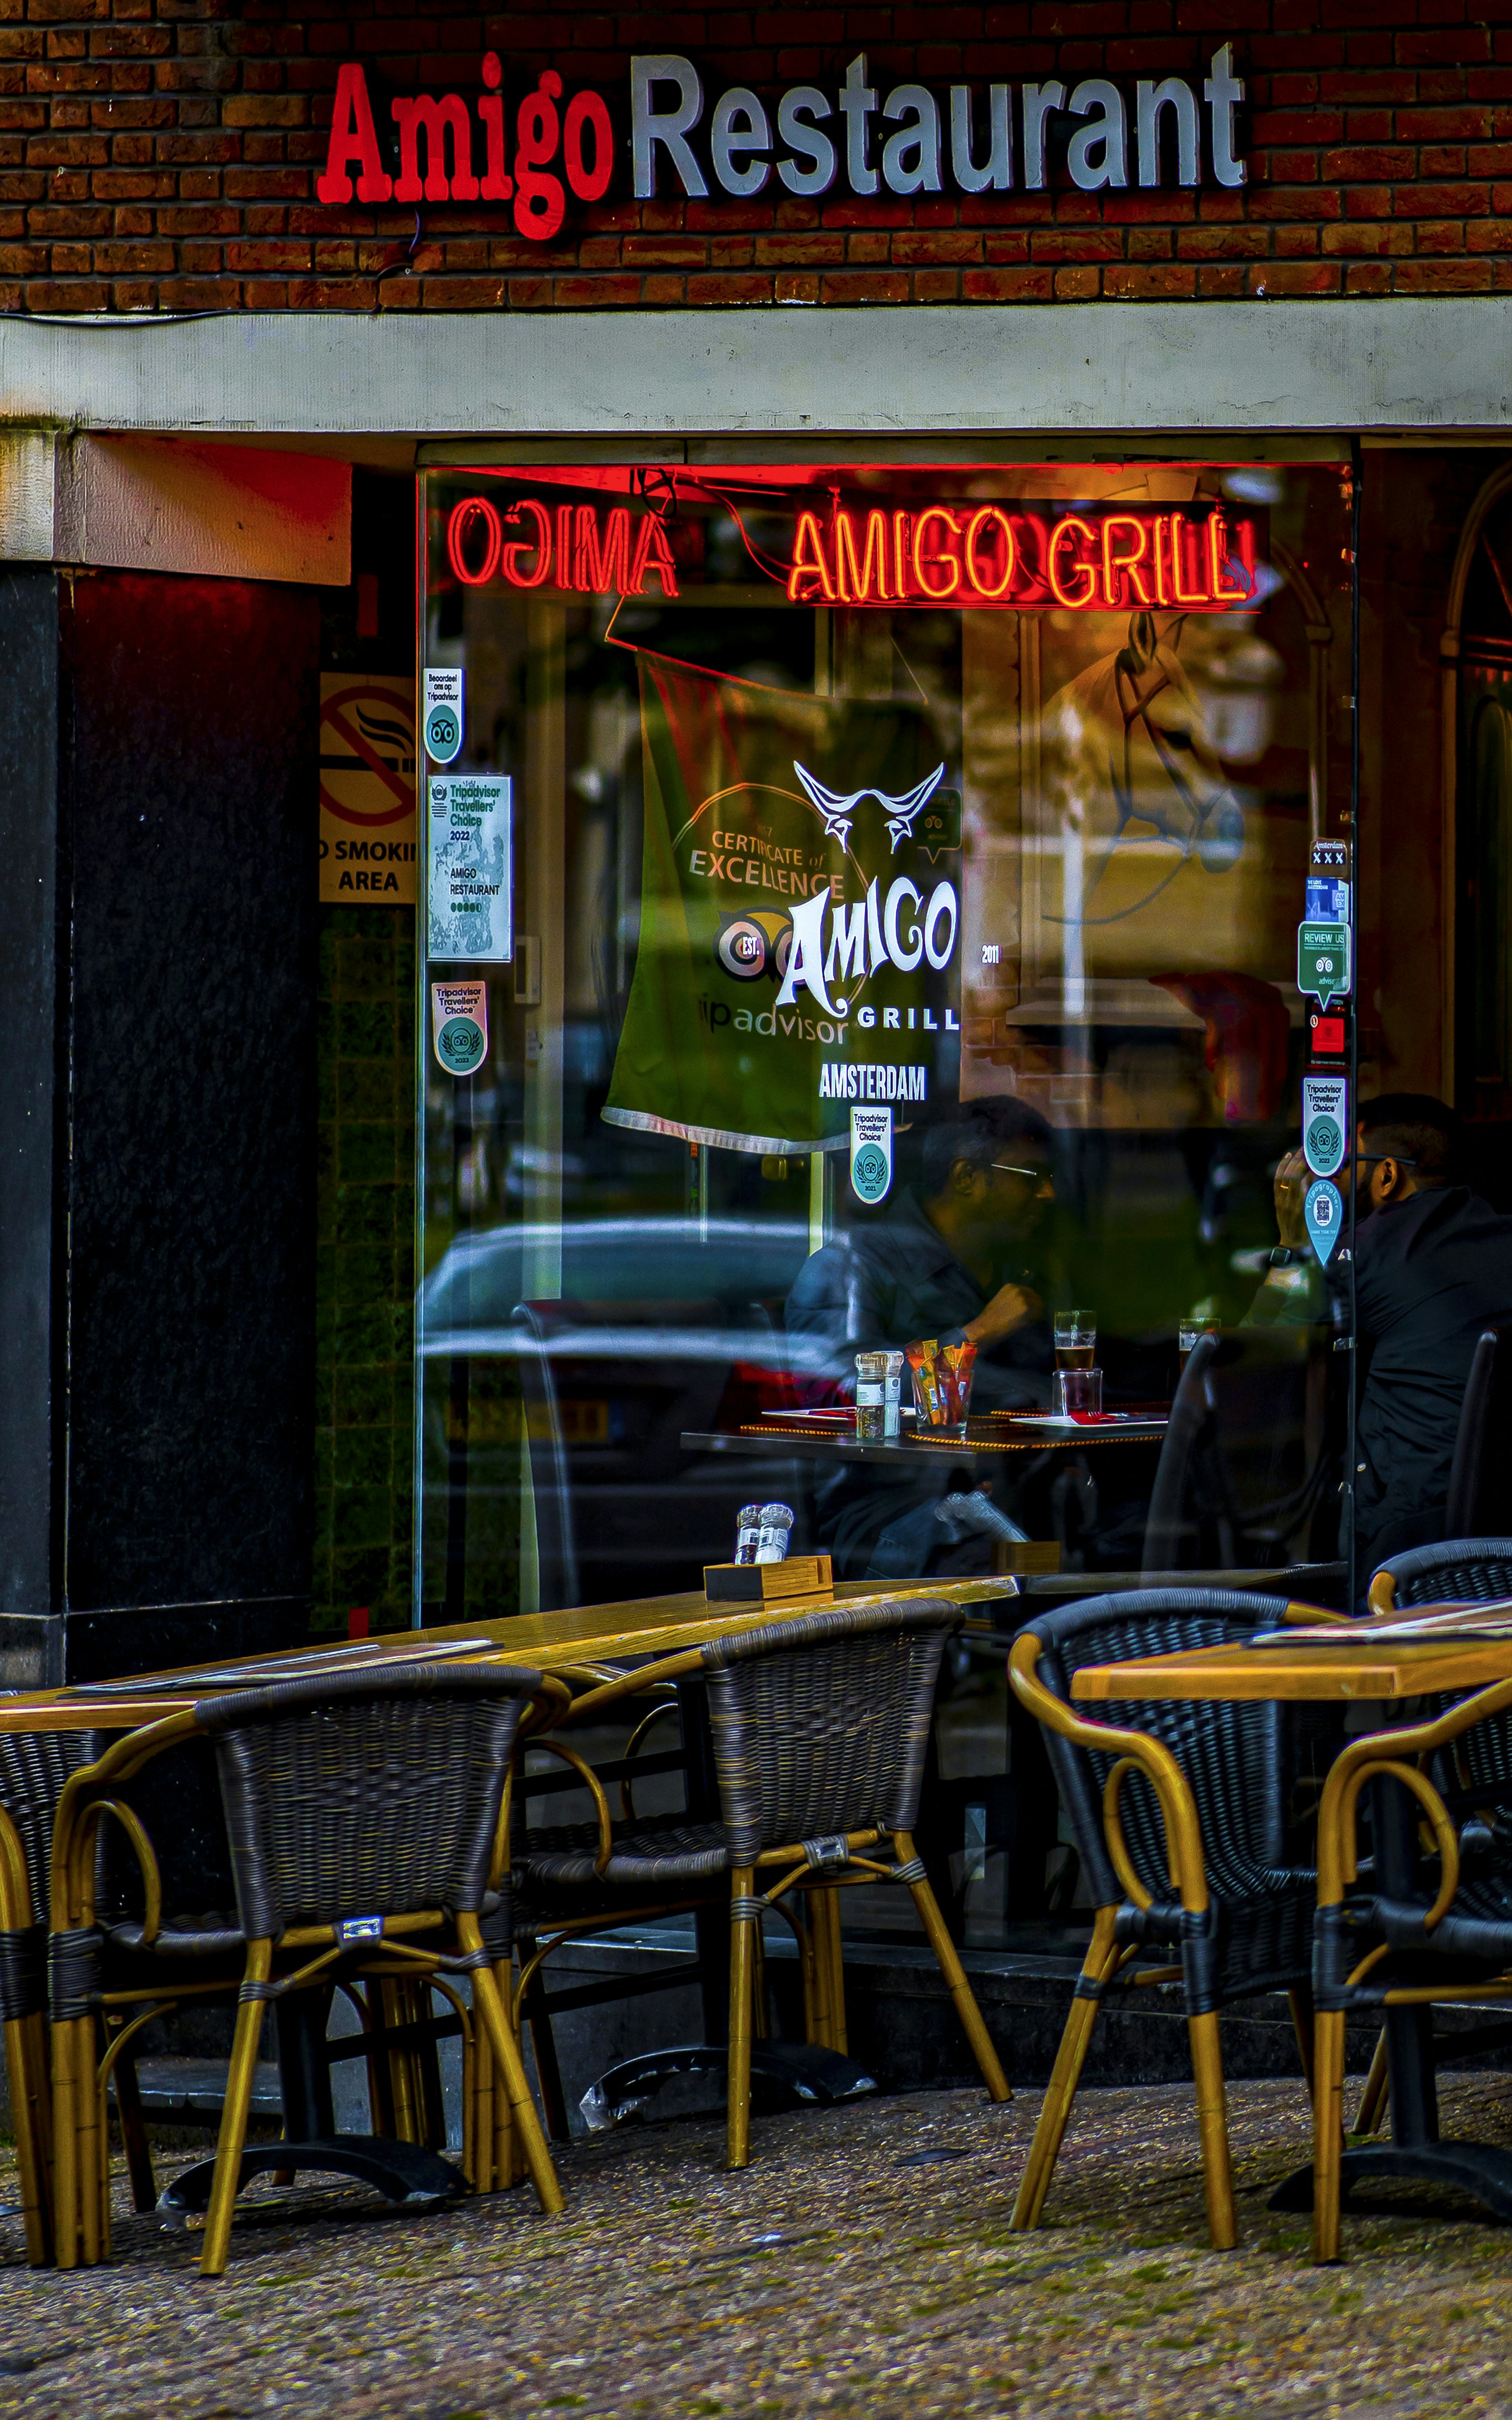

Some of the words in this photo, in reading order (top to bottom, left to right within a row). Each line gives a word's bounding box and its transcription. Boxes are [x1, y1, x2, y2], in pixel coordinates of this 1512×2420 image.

[317, 51, 613, 241] Amigo
[631, 42, 1248, 198] Restaurant
[788, 506, 1015, 603] AMIGO
[1048, 512, 1249, 608] GRILL
[429, 674, 457, 682] Beoordeel
[444, 684, 452, 692] op
[428, 692, 459, 702] Tripadvisor
[450, 784, 501, 799] Tripadvisor
[450, 799, 495, 813] Travellers'
[450, 814, 483, 827] Choice
[450, 831, 470, 841] 2022
[712, 831, 803, 866] CERTIFICATE
[809, 852, 826, 871] of
[1313, 841, 1343, 851] Amsterdam
[450, 868, 476, 879] AMIGO
[689, 849, 845, 899] EXCELLENCE
[338, 870, 399, 891] AREA
[450, 884, 500, 895] RESTAURANT
[1305, 933, 1332, 944] REVIEW
[1335, 934, 1345, 944] US
[742, 936, 760, 955] EST.
[775, 875, 956, 1018] AMIGO
[982, 944, 1000, 964] 2011
[436, 987, 481, 998] Tripadvisor
[438, 996, 480, 1006] Travellers'
[445, 1005, 474, 1015] Choice
[857, 1006, 960, 1030] GRILL
[819, 1064, 925, 1101] AMSTERDAM
[1307, 1084, 1342, 1095] Tripadvisor
[1308, 1093, 1340, 1103] Travellers'
[1312, 1103, 1336, 1113] Choice
[854, 1113, 888, 1124] Tripadvisor
[855, 1122, 886, 1132] Travellers'
[859, 1132, 881, 1141] Choice
[1306, 1183, 1339, 1209] Tripographer
